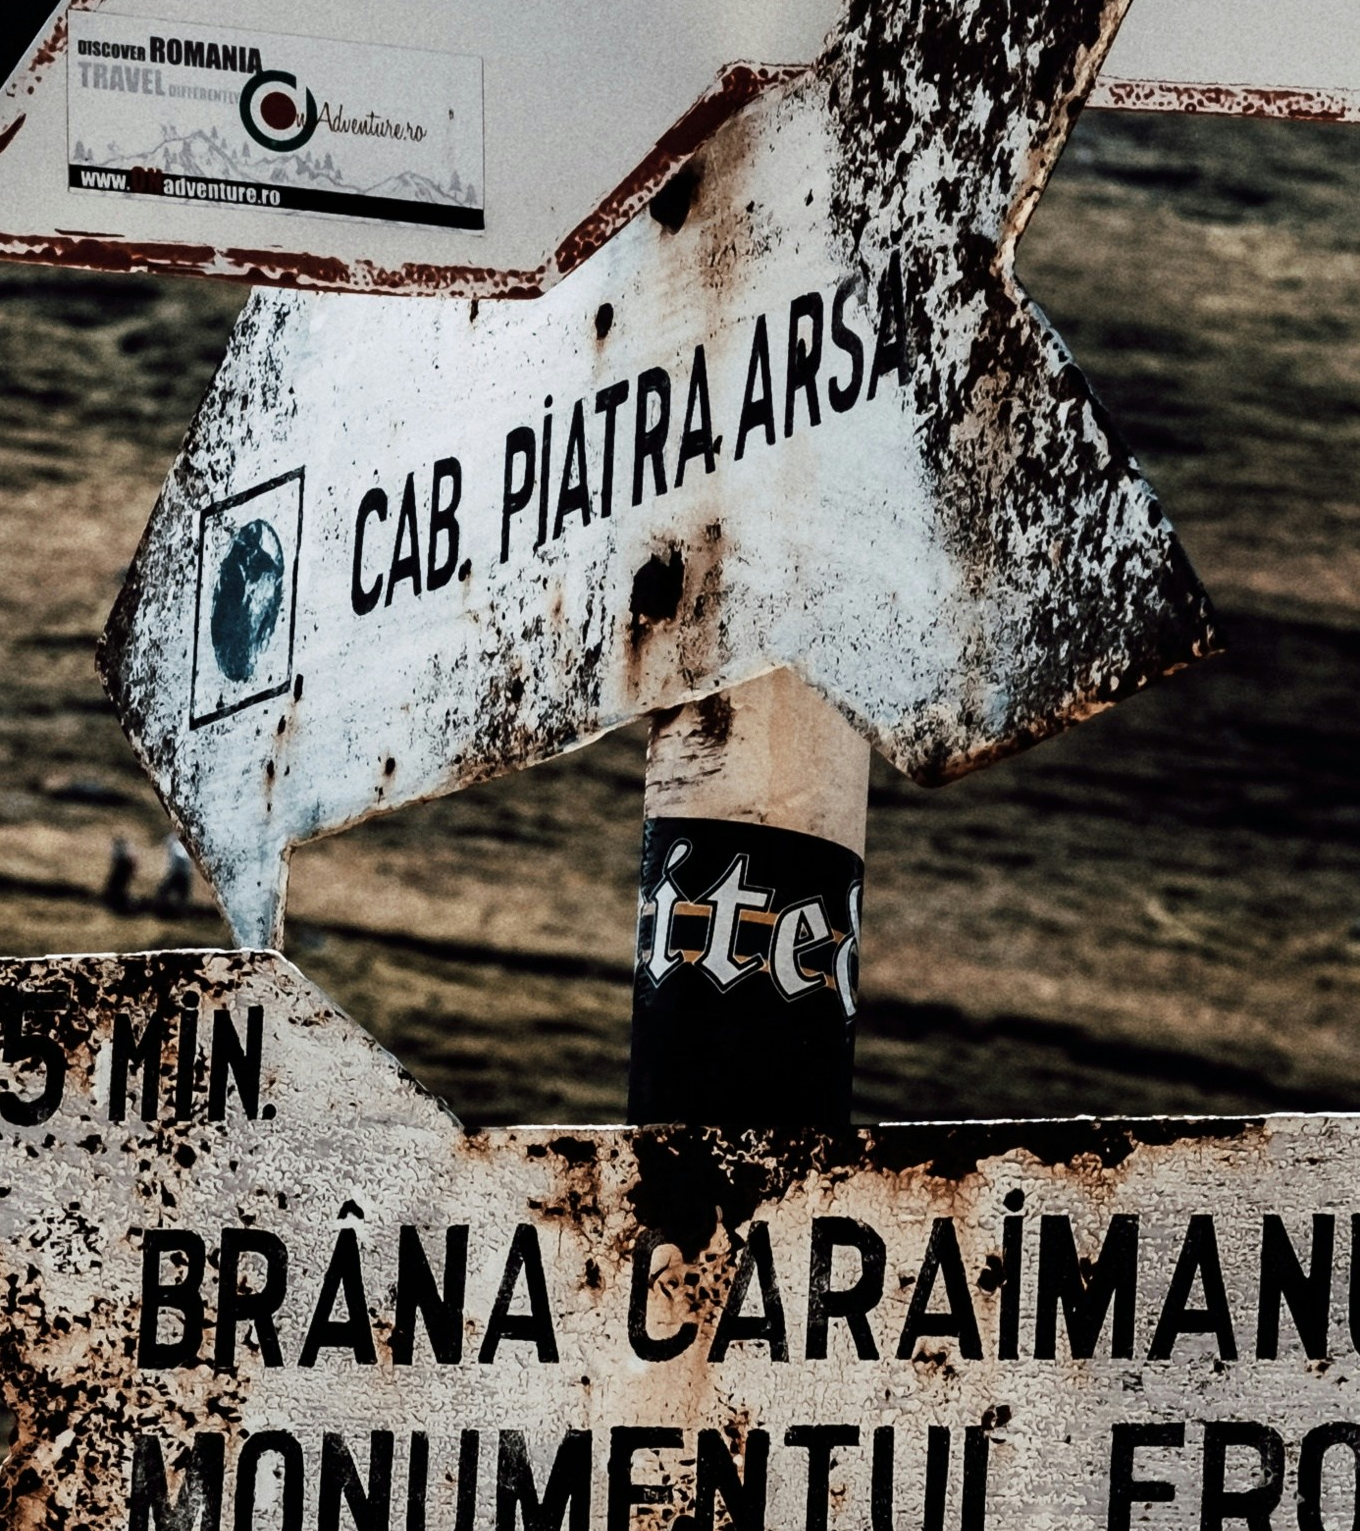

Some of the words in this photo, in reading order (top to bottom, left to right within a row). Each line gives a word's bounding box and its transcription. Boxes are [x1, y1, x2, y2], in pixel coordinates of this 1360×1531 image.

[78, 39, 146, 62] DISCOVER
[149, 36, 263, 75] ROMANIA
[78, 61, 166, 96] TRAVEL
[168, 84, 240, 105] DIFFERENTLY
[351, 456, 472, 616] CAB.
[734, 249, 914, 462] ARSA
[134, 1199, 561, 1369] BRÂNA
